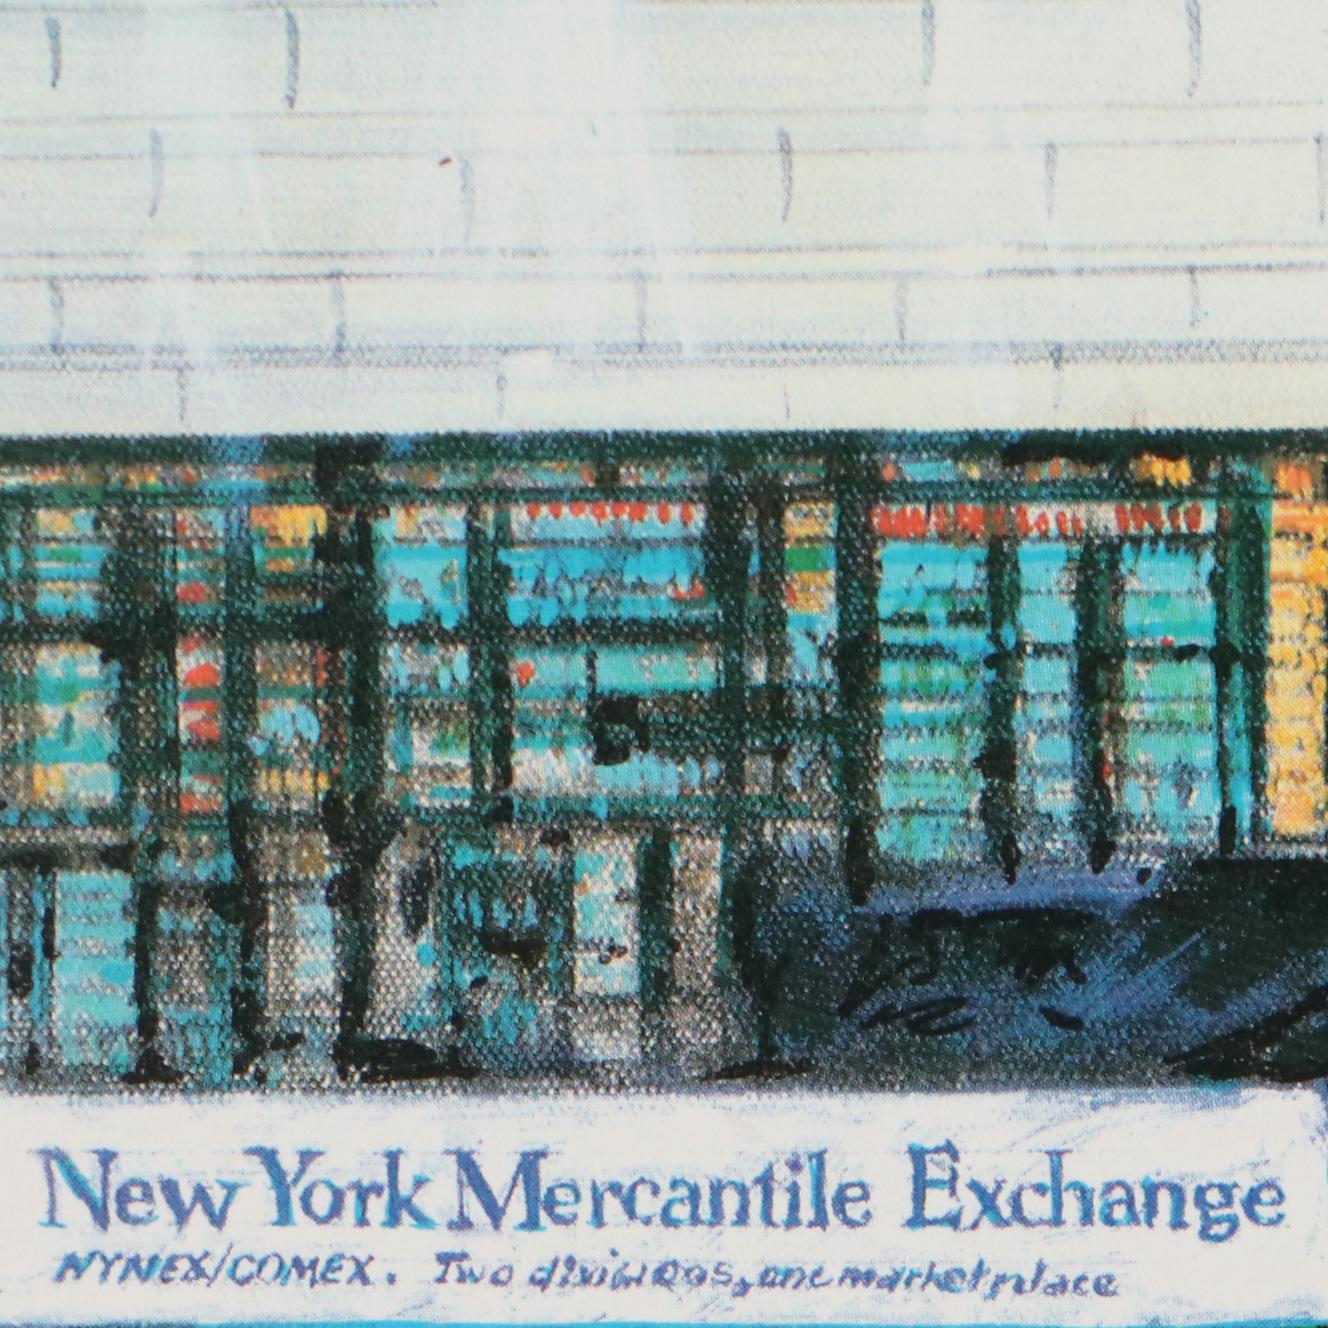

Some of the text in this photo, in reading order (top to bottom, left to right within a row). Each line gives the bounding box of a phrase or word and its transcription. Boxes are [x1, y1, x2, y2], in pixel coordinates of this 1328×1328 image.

[34, 1138, 1287, 1243] New York Mercantile Exchange
[435, 1250, 515, 1287] Two
